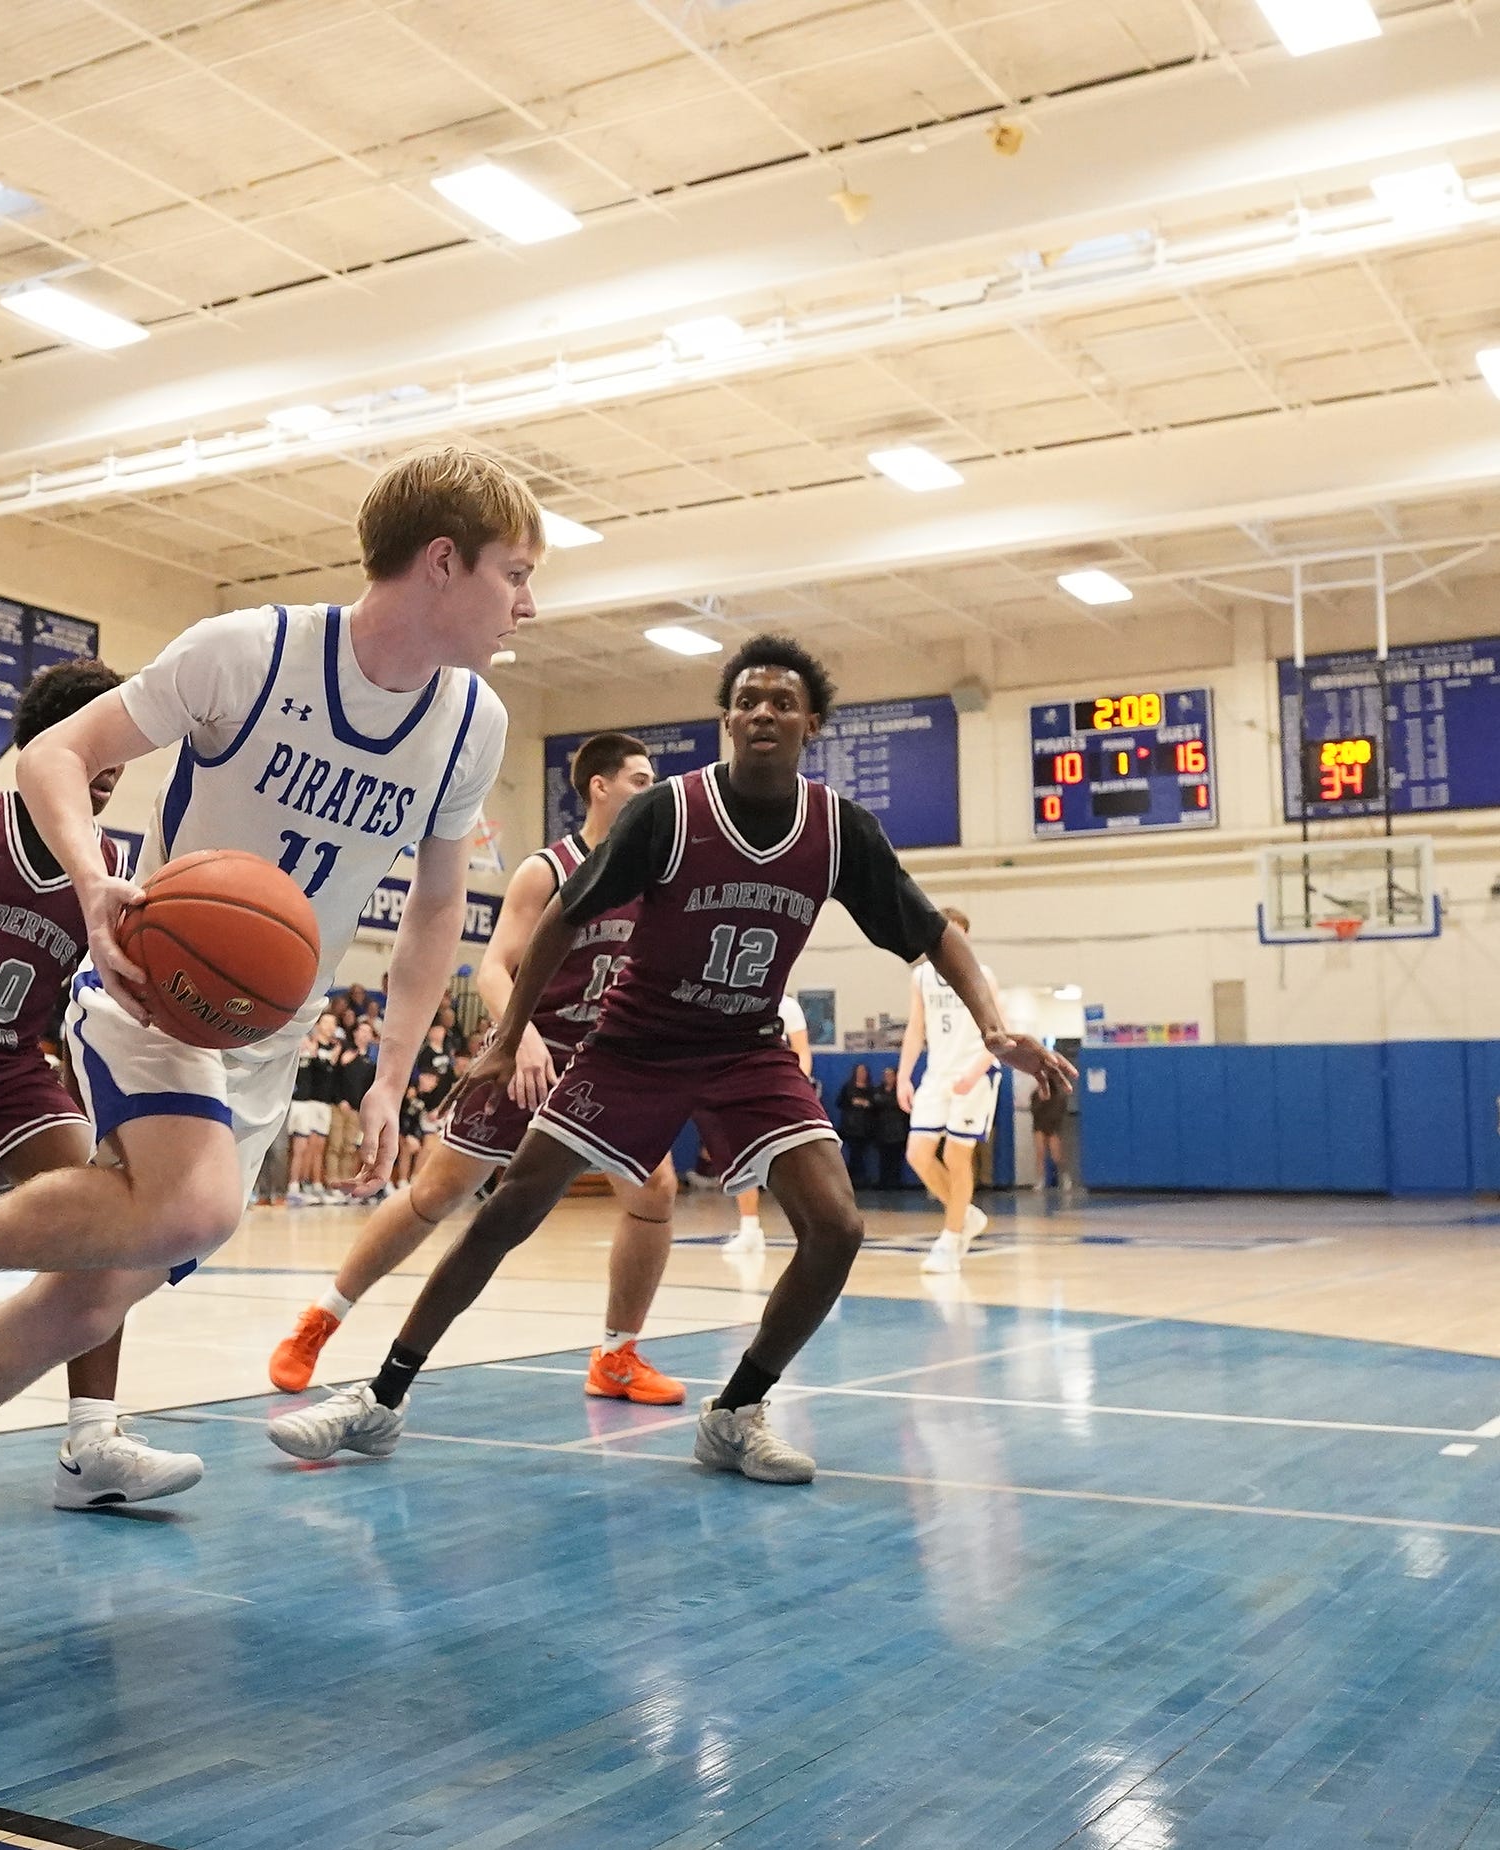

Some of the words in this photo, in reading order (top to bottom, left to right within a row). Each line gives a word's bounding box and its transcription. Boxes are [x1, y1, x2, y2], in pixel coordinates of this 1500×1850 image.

[1093, 693, 1161, 731] 2:08
[1156, 722, 1201, 744] GUEST
[1054, 751, 1083, 784] 10
[1117, 751, 1129, 776] 1
[1175, 739, 1207, 774] 16
[1321, 740, 1371, 766] 2:08
[254, 742, 416, 837] PIRATES
[1196, 784, 1209, 808] 1
[1320, 763, 1363, 800] 34
[1043, 795, 1062, 821] 0
[277, 829, 343, 898] 11
[684, 882, 816, 927] ALBERTUS
[702, 924, 778, 988] 12
[941, 1013, 952, 1034] 5
